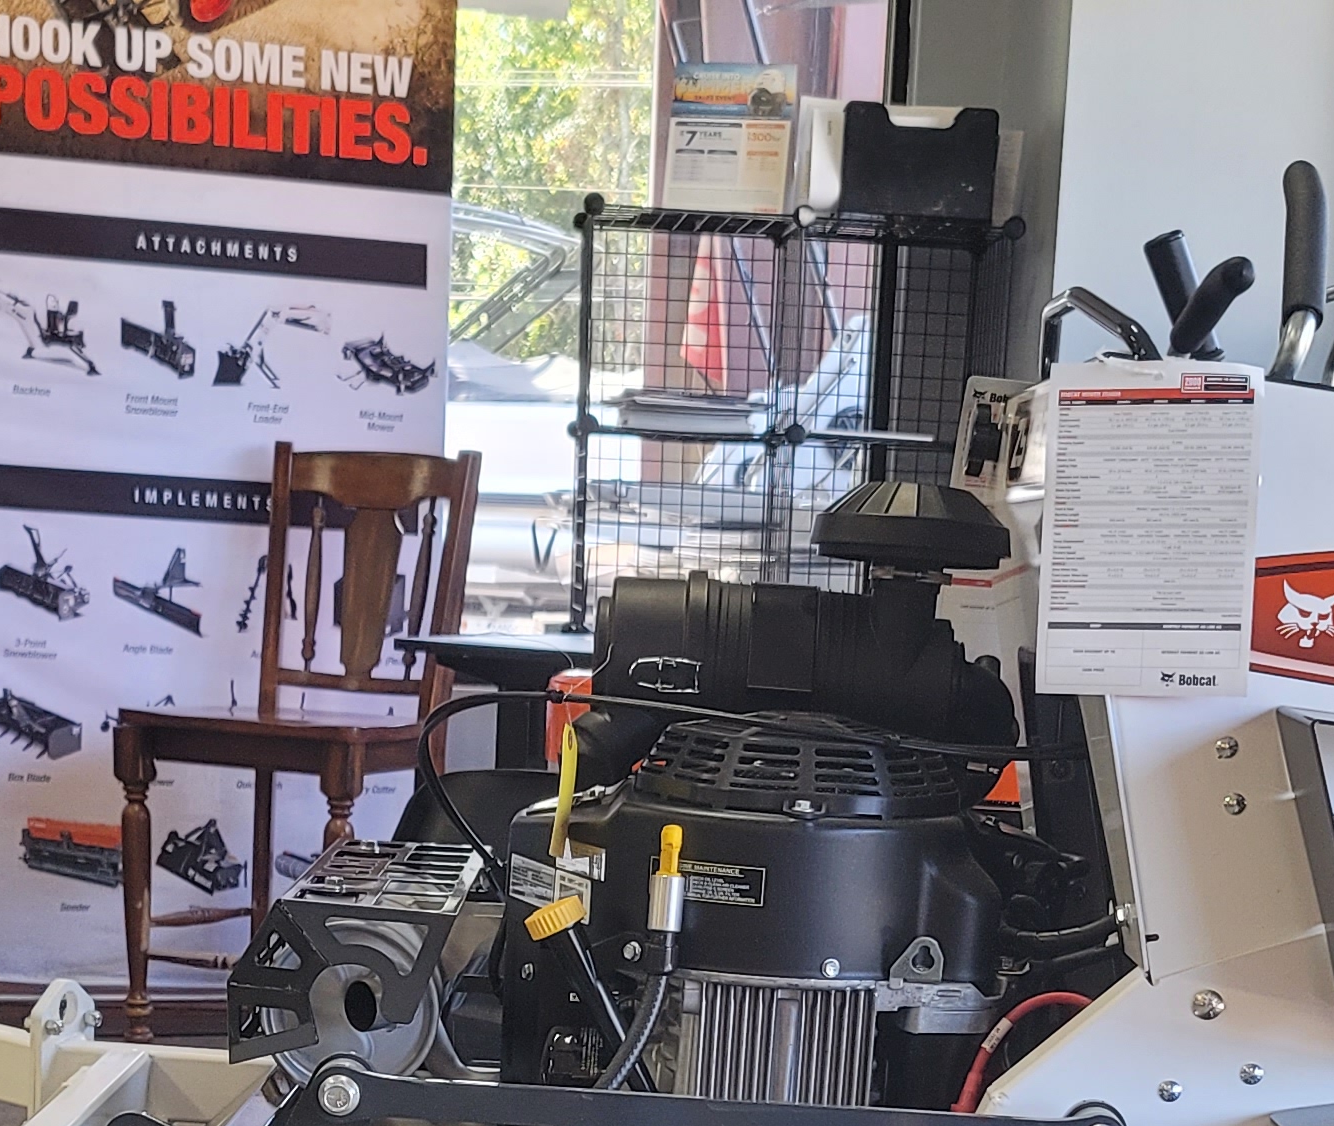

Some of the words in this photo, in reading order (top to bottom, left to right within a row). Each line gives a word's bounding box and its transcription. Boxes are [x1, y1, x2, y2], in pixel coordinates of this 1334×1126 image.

[115, 26, 172, 74] UP
[186, 35, 306, 88] SOME
[320, 49, 413, 98] NEW
[685, 130, 699, 147] 7
[136, 232, 299, 263] ATTACHMENTS
[12, 384, 51, 397] Backhoe
[125, 393, 148, 405] Front
[151, 395, 179, 407] Mount
[989, 392, 1011, 404] Bob
[125, 405, 179, 418] Snowblower
[247, 402, 289, 414] Front-End
[253, 414, 283, 425] Loader
[359, 410, 404, 423] Mid-Mount
[367, 422, 395, 433] Mower
[3, 648, 58, 661] Snowblower
[123, 642, 147, 656] Angle
[148, 643, 174, 656] Blade
[1178, 674, 1217, 687] Bobcat
[694, 865, 740, 875] MAINTENANCE
